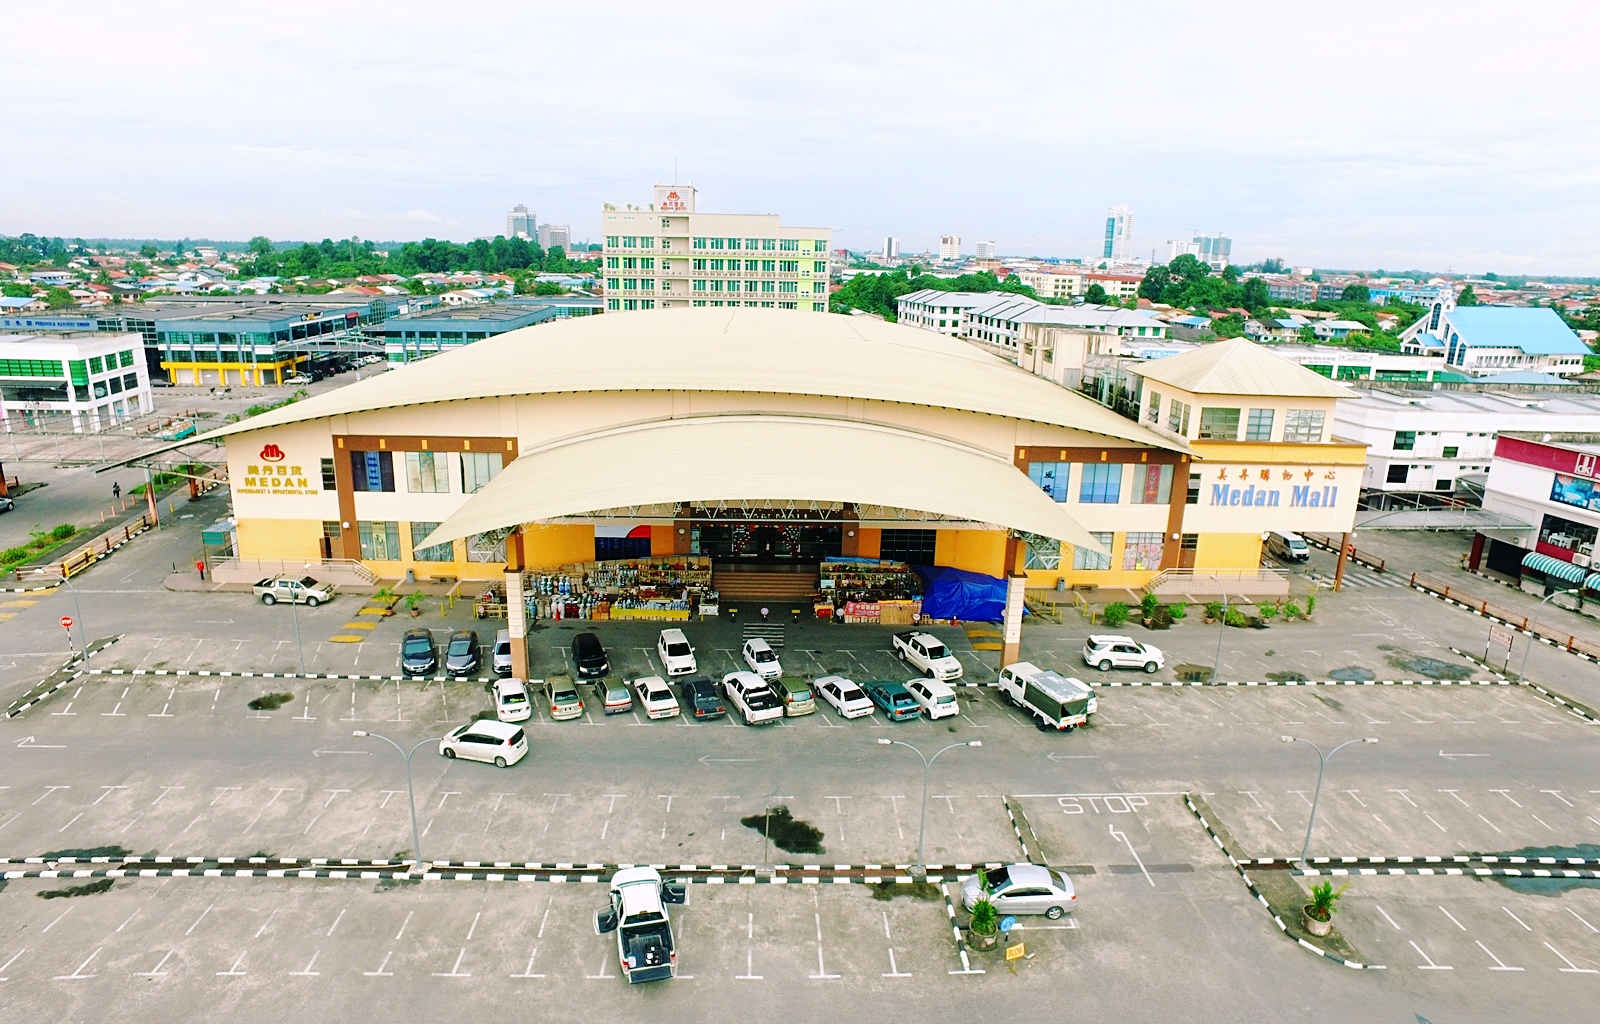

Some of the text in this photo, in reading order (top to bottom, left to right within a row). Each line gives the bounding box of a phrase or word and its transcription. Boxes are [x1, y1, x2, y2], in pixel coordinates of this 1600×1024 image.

[244, 477, 308, 487] MEDAN
[1210, 483, 1338, 508] Medan Mall
[1058, 796, 1149, 814] STOP
